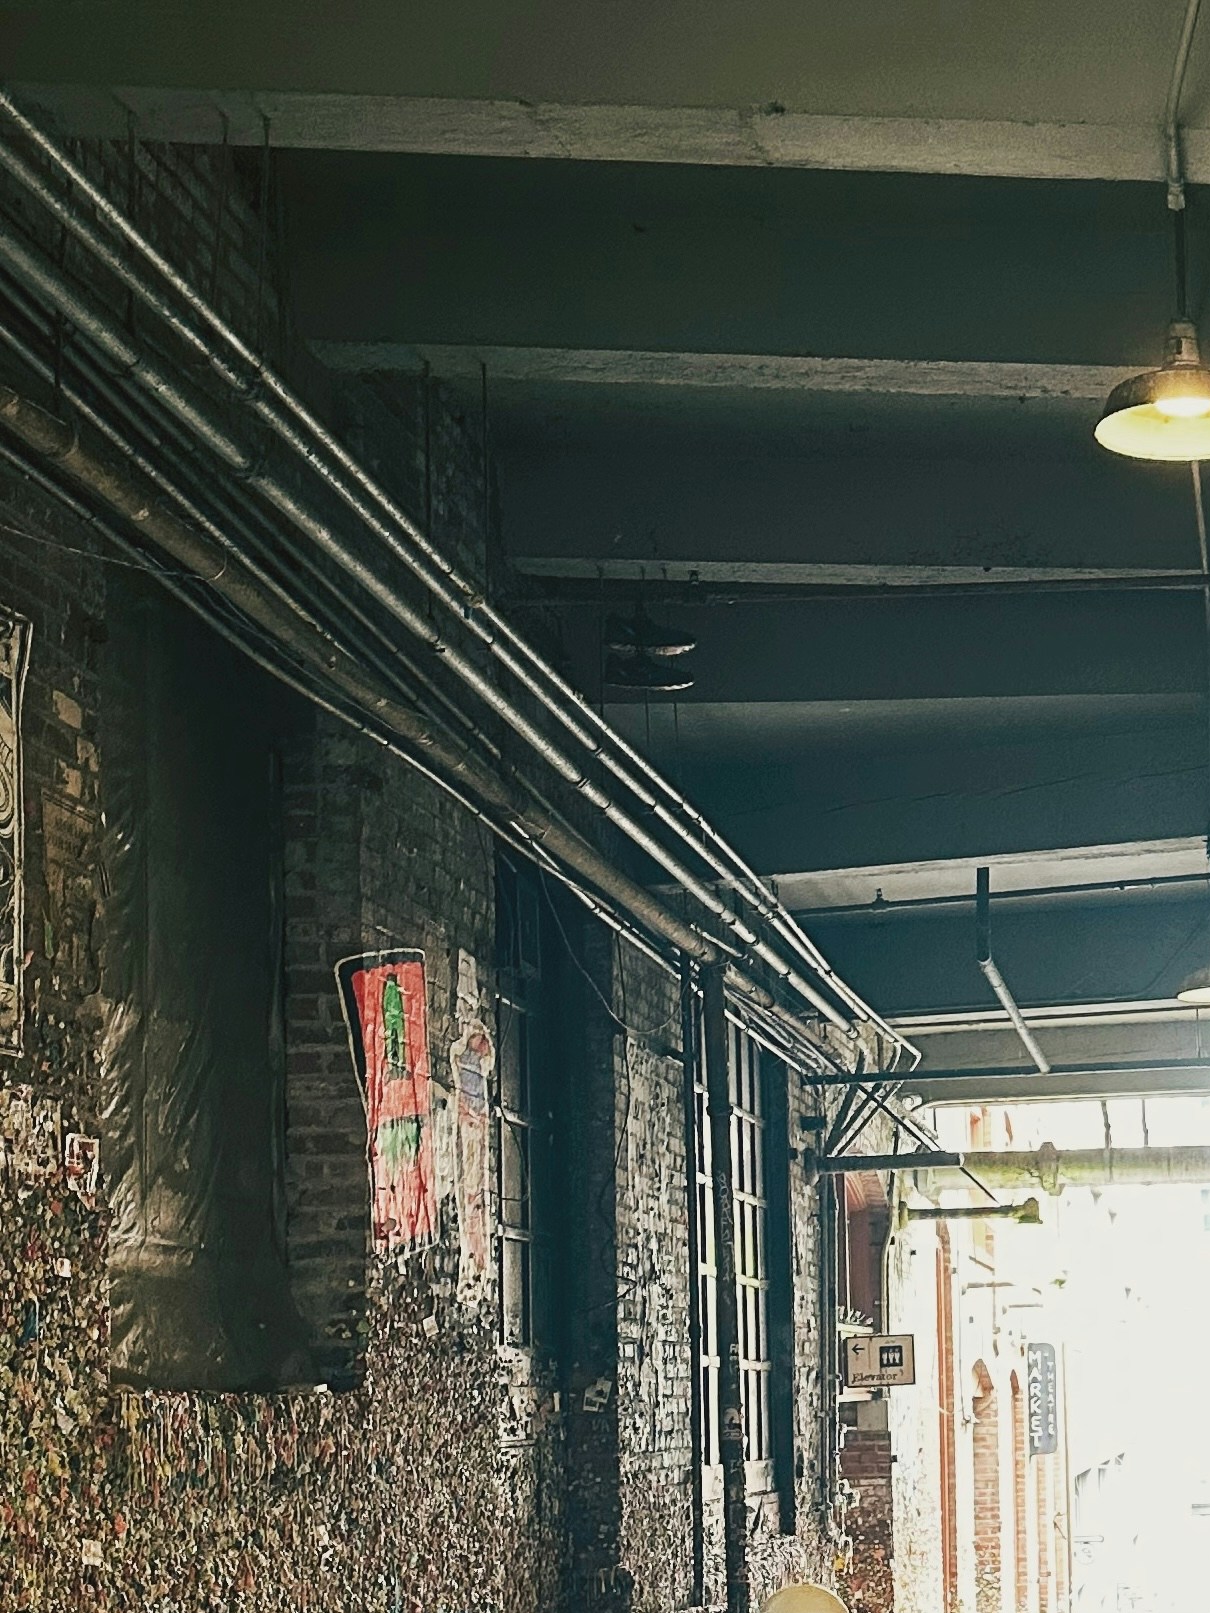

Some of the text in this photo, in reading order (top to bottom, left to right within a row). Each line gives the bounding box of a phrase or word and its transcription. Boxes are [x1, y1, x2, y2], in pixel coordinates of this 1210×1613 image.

[852, 1372, 898, 1384] Elevator
[1028, 1350, 1043, 1448] MARKET
[1047, 1361, 1055, 1435] THEATRE
